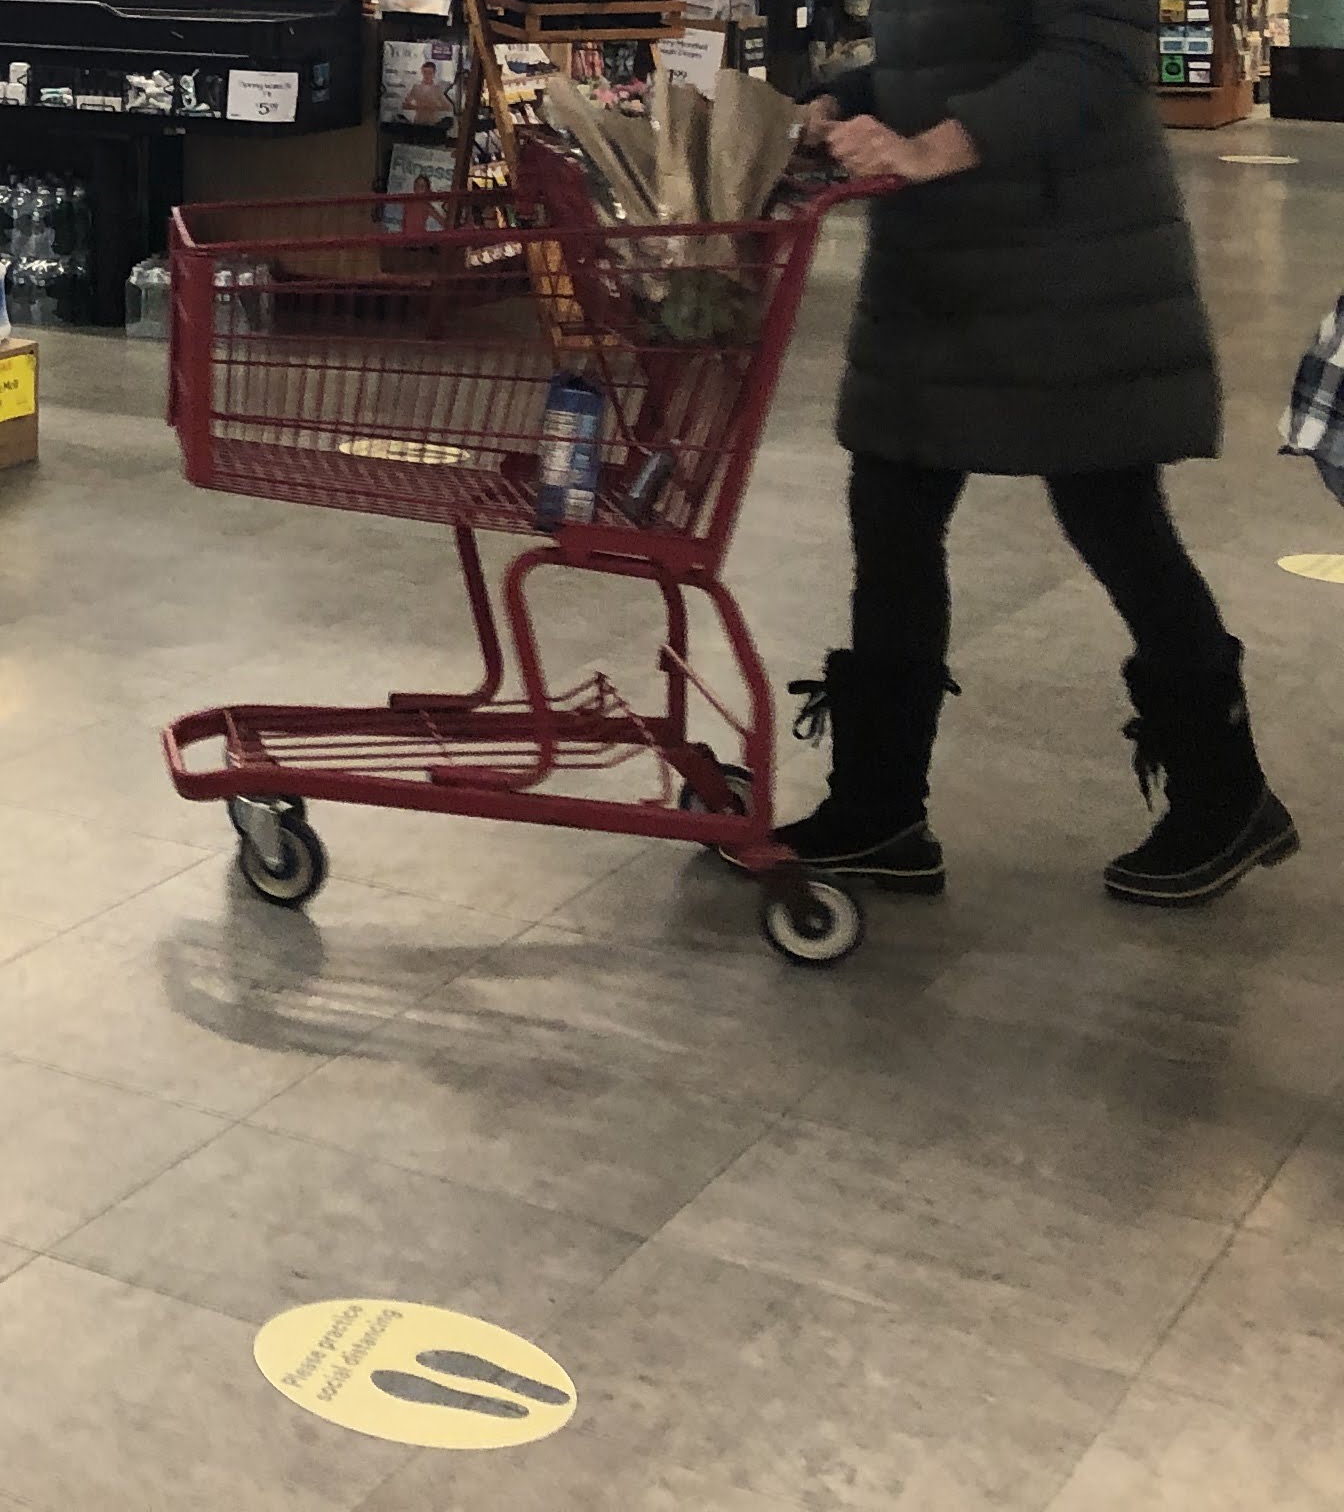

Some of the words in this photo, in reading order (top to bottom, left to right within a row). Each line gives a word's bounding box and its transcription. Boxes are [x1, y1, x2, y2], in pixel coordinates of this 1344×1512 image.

[281, 1349, 327, 1388] Please
[318, 1303, 364, 1352] practice
[315, 1361, 352, 1403] social
[341, 1308, 404, 1367] distancing
